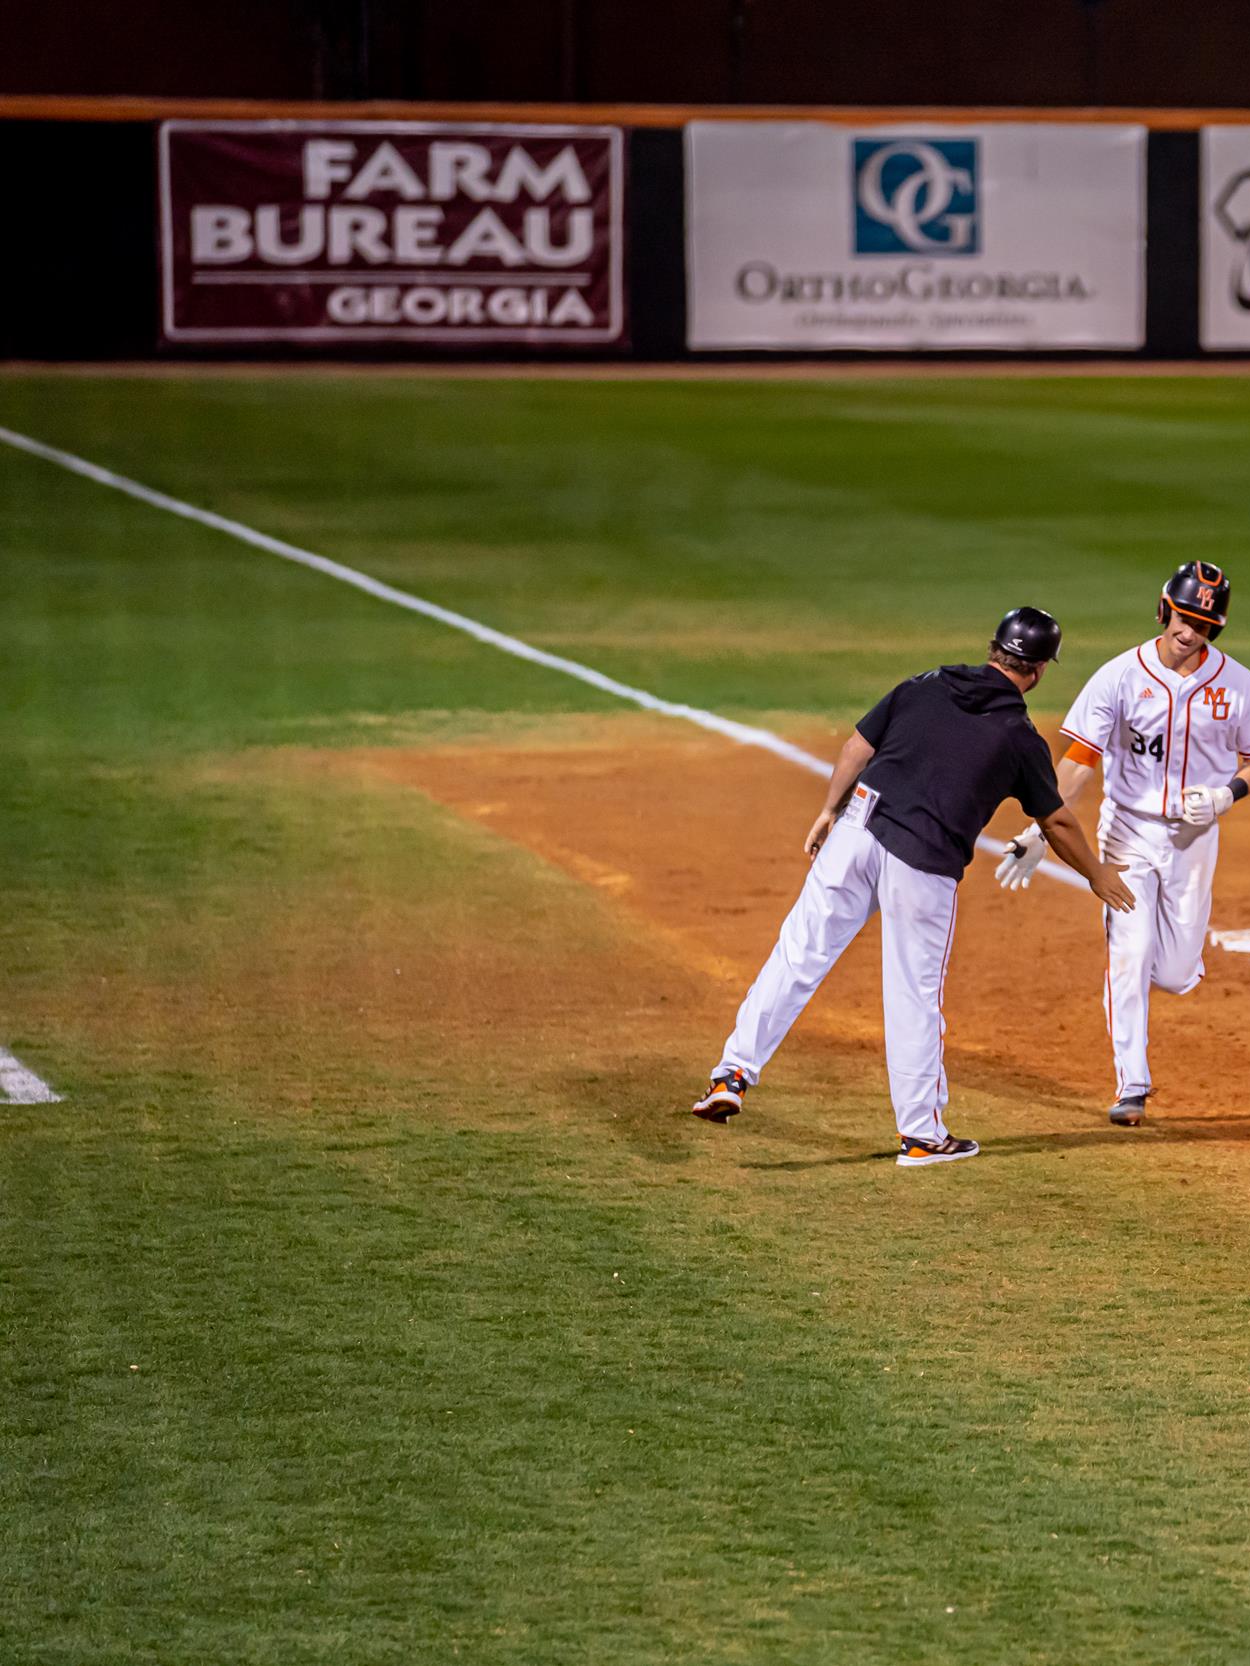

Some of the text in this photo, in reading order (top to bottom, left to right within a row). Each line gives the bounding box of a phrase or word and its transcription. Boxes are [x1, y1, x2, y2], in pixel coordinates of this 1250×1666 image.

[303, 139, 593, 202] FARM
[190, 204, 595, 268] BUREAU
[326, 286, 596, 326] GEORGIA
[1128, 726, 1164, 763] 34
